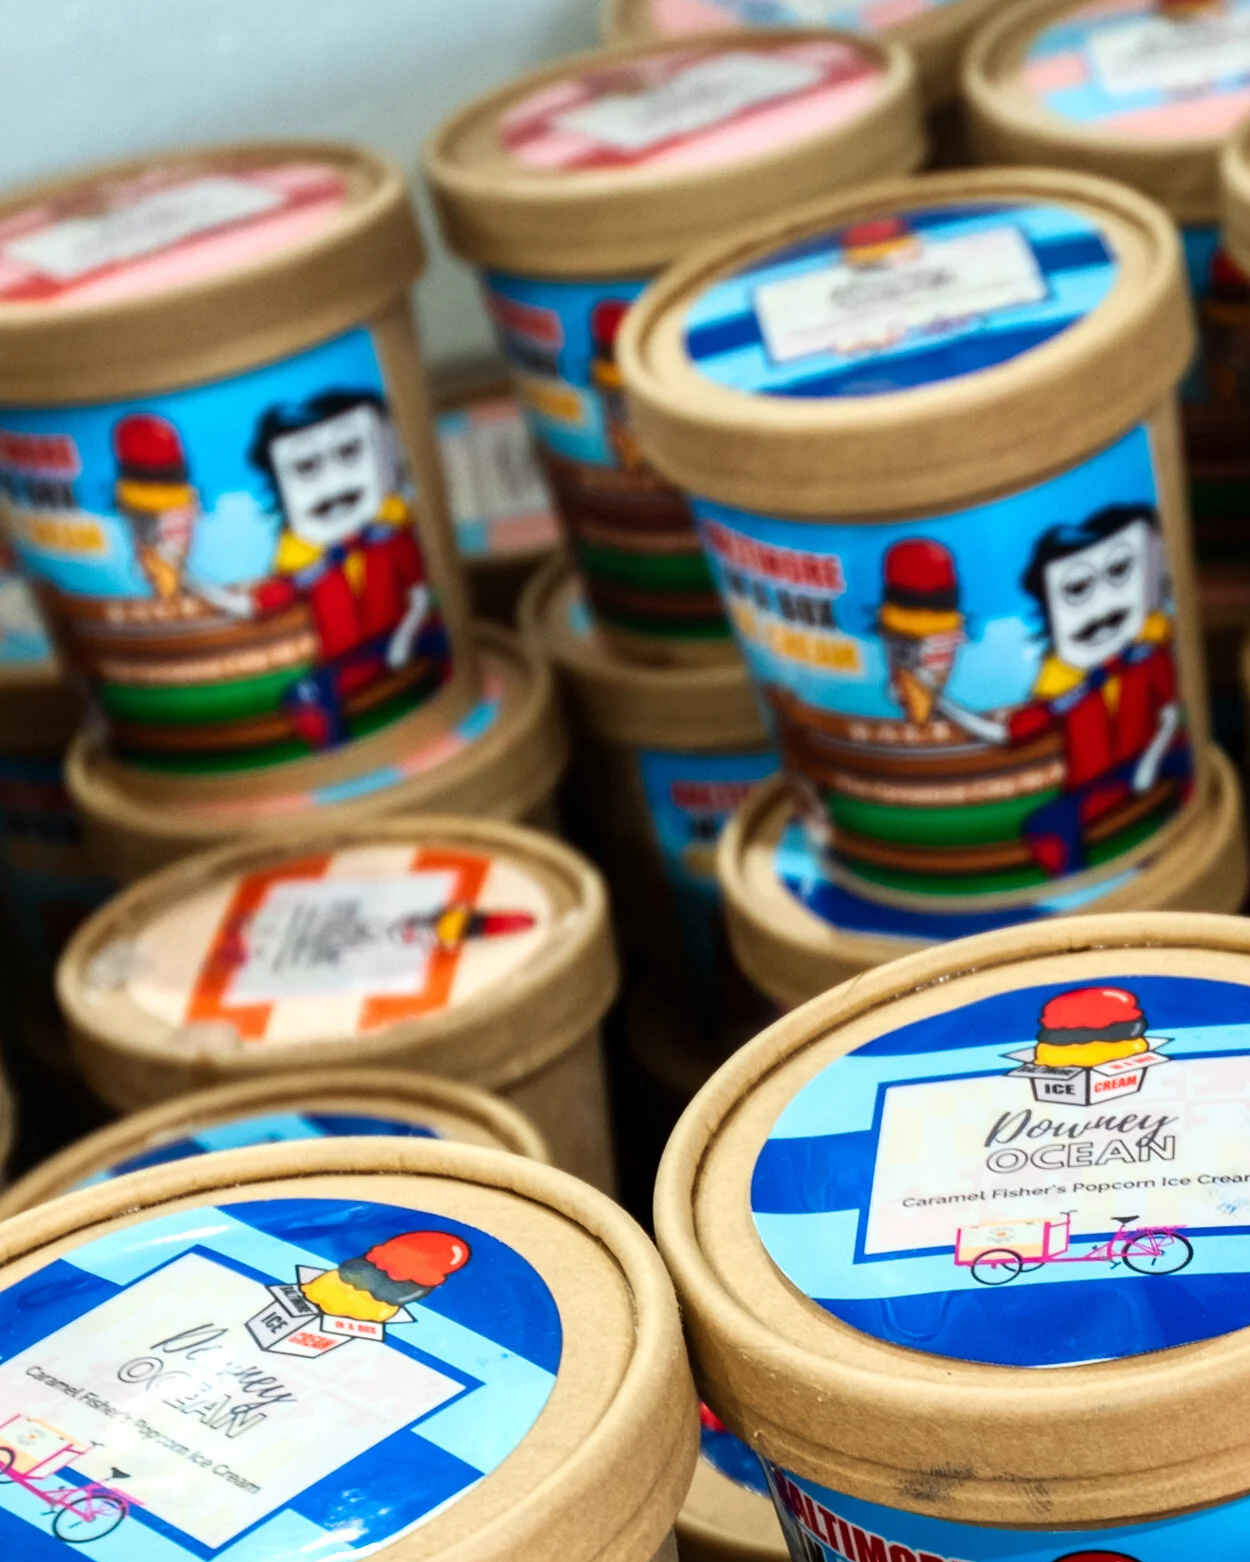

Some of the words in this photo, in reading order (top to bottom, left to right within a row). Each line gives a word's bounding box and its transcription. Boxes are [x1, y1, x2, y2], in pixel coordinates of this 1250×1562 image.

[1044, 1083, 1076, 1096] ICE
[1093, 1075, 1138, 1094] CREAM
[984, 1109, 1179, 1148] Downey
[986, 1135, 1176, 1174] OCEAN
[902, 1192, 987, 1209] Caramel
[991, 1183, 1067, 1201] Fisher's
[1072, 1179, 1155, 1195] Popcorn
[1162, 1177, 1191, 1188] Ice
[260, 1311, 289, 1334] ICE
[25, 1365, 84, 1399] Caramel
[212, 1463, 262, 1495] Cream
